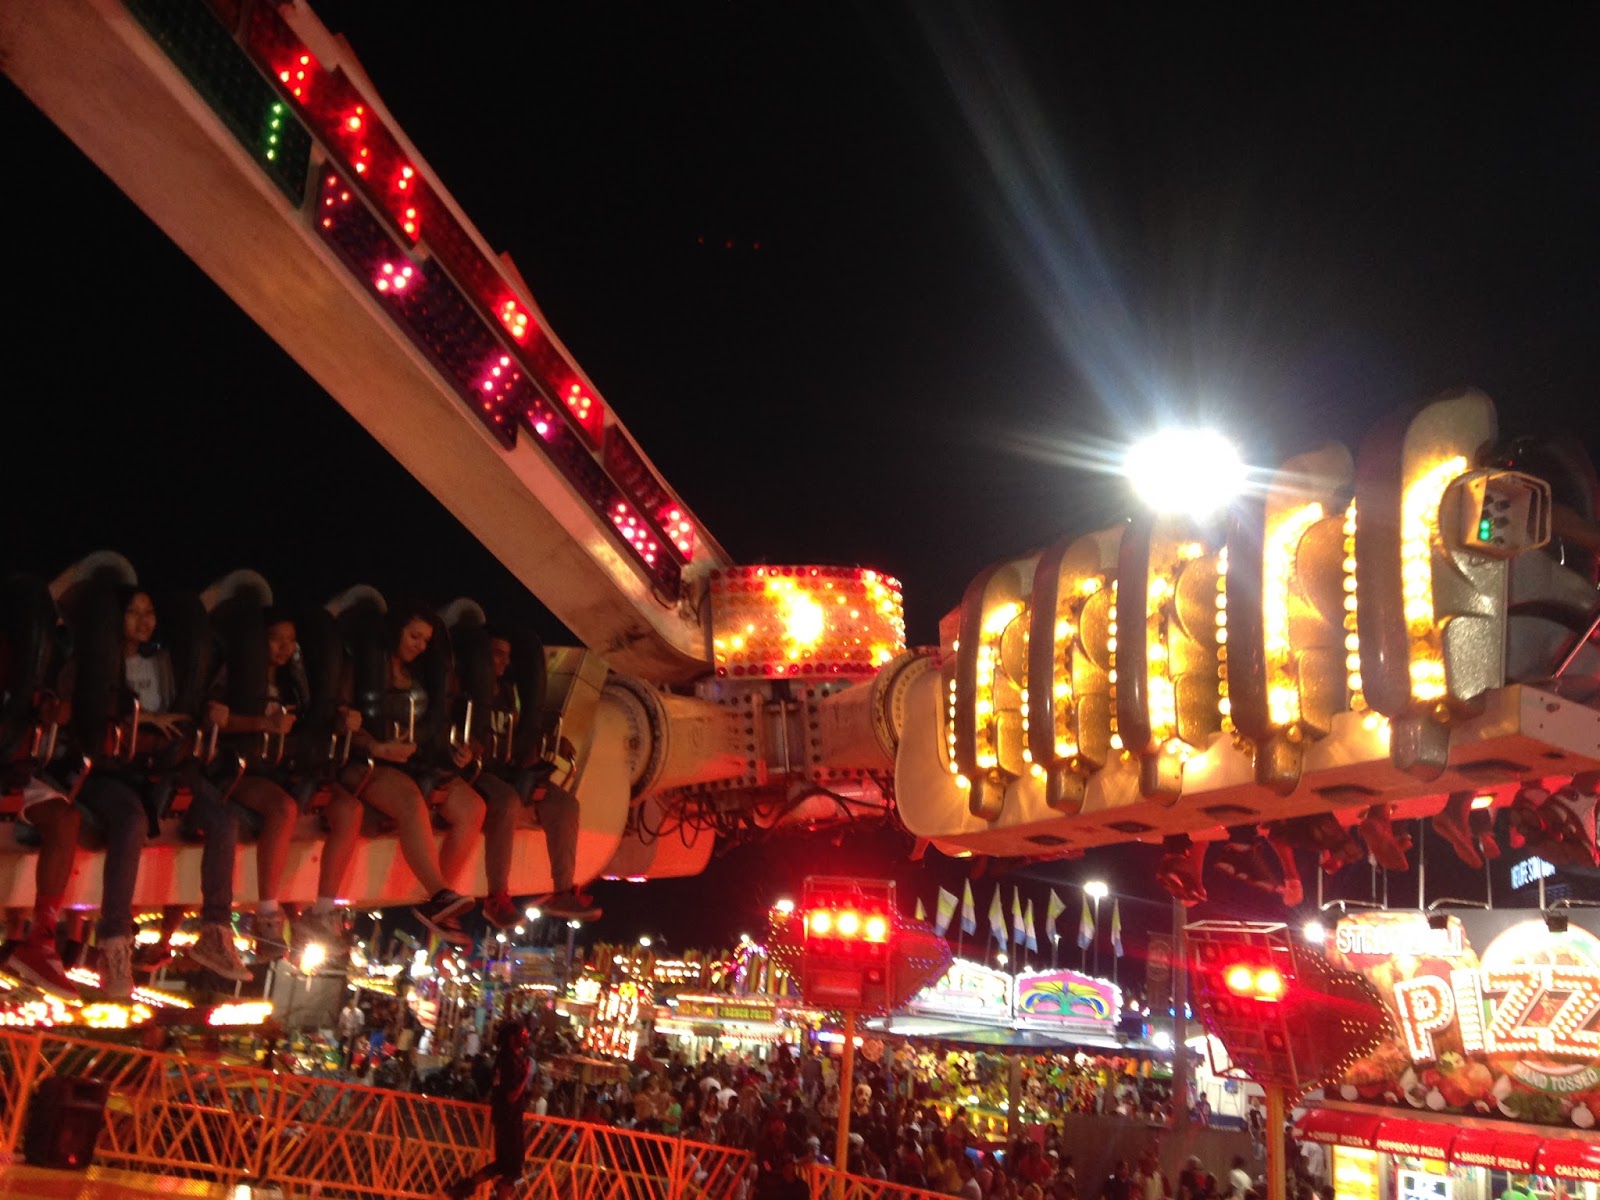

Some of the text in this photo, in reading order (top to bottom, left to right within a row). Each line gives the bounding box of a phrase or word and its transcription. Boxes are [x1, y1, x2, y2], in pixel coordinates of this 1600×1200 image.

[1550, 1067, 1598, 1092] TOSSED
[1341, 1135, 1363, 1146] PIZZA
[1420, 1146, 1445, 1159] PIZZA
[1461, 1151, 1522, 1170] SAUSAGE PIZZA
